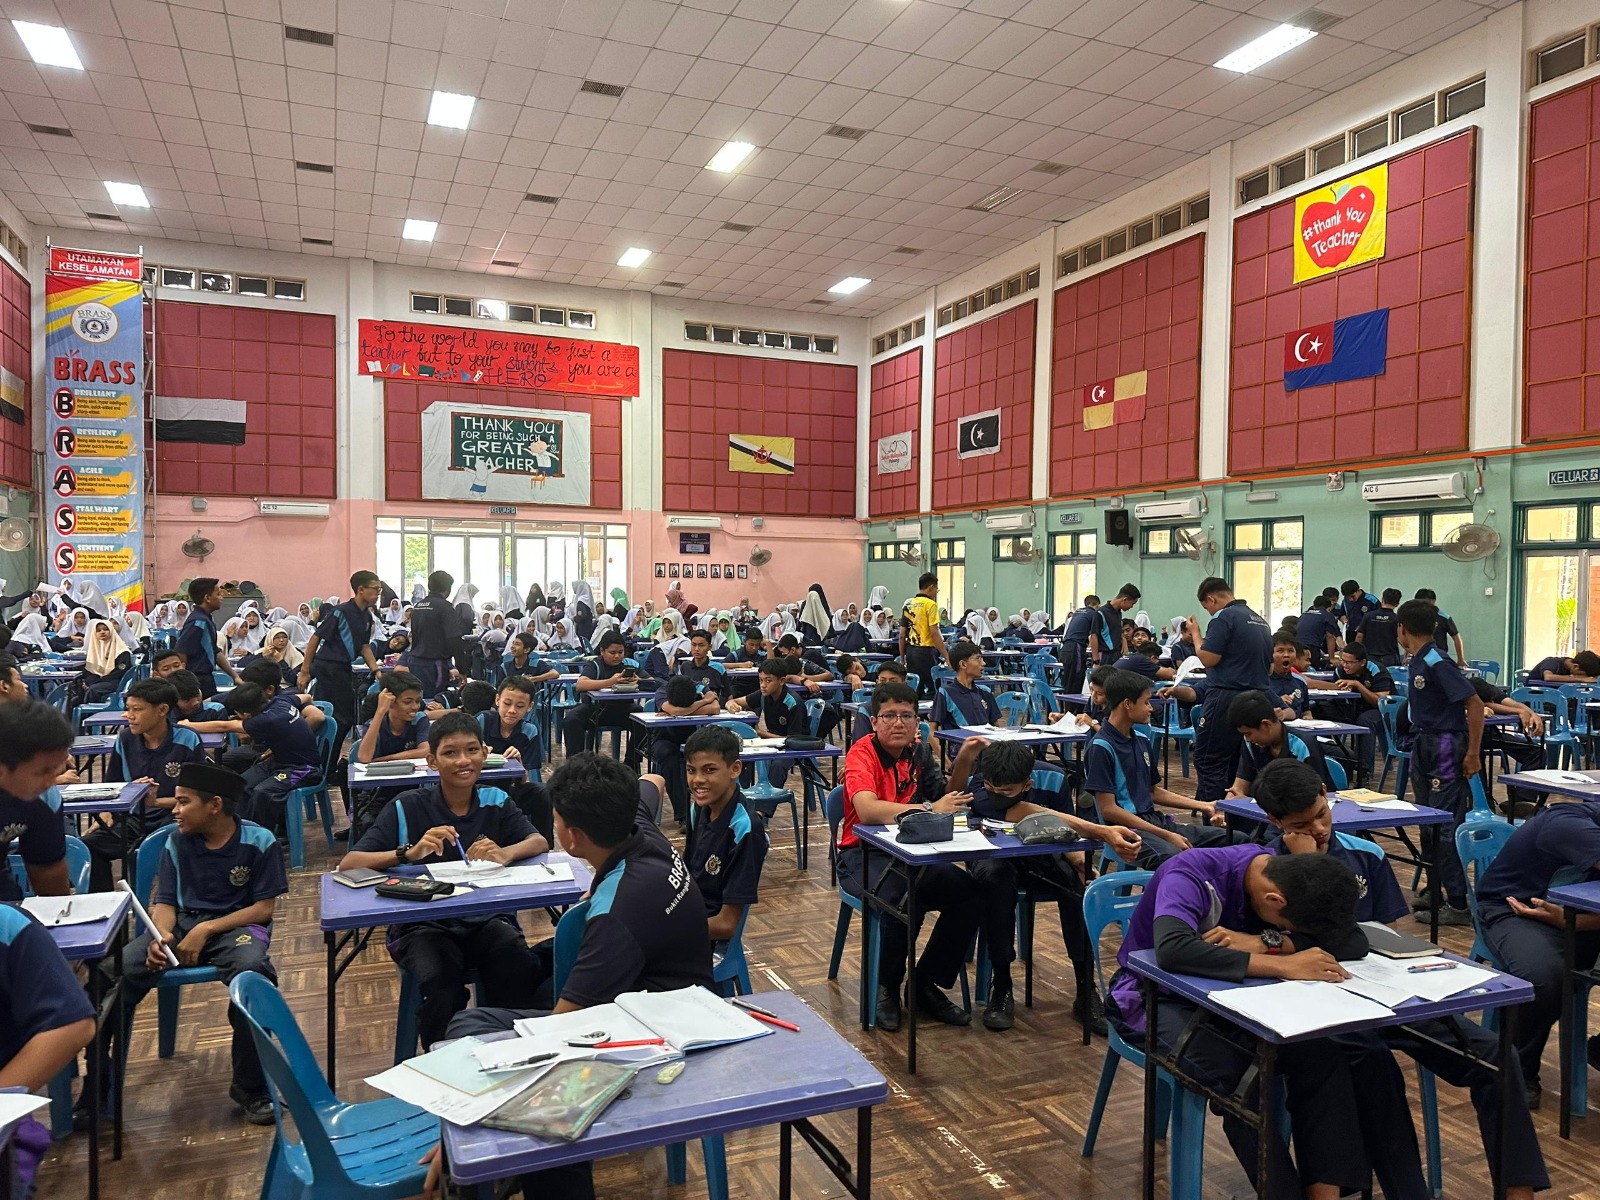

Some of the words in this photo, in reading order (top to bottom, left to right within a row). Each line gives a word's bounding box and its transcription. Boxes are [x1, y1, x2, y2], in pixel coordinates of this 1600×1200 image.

[1303, 210, 1342, 240] #thank
[1346, 206, 1366, 222] You
[1312, 229, 1362, 257] Teacher
[58, 262, 132, 276] KESELAMATAN
[68, 253, 124, 266] UTAMAKAN
[78, 310, 112, 320] BRASS
[398, 326, 426, 343] the
[432, 331, 480, 349] world
[485, 339, 508, 355] you
[544, 340, 560, 356] be
[566, 342, 596, 360] just
[601, 350, 611, 361] a
[54, 356, 136, 384] BRASS
[417, 344, 442, 363] but
[445, 344, 464, 366] to
[568, 362, 592, 383] you
[597, 364, 621, 377] are
[625, 366, 636, 377] a
[58, 392, 74, 412] B
[74, 388, 116, 398] BRILLIANT
[76, 428, 117, 436] RESILIENT
[460, 416, 514, 432] THANK
[524, 420, 555, 434] YOU
[57, 432, 74, 452] R
[461, 431, 480, 439] FOR
[486, 432, 514, 441] BEING
[516, 433, 540, 442] SUCH
[462, 440, 524, 455] GREAT
[52, 470, 76, 490] A
[1551, 470, 1588, 483] KELUAR
[59, 509, 73, 529] S
[59, 549, 73, 569] S
[665, 897, 680, 914] Bukit
